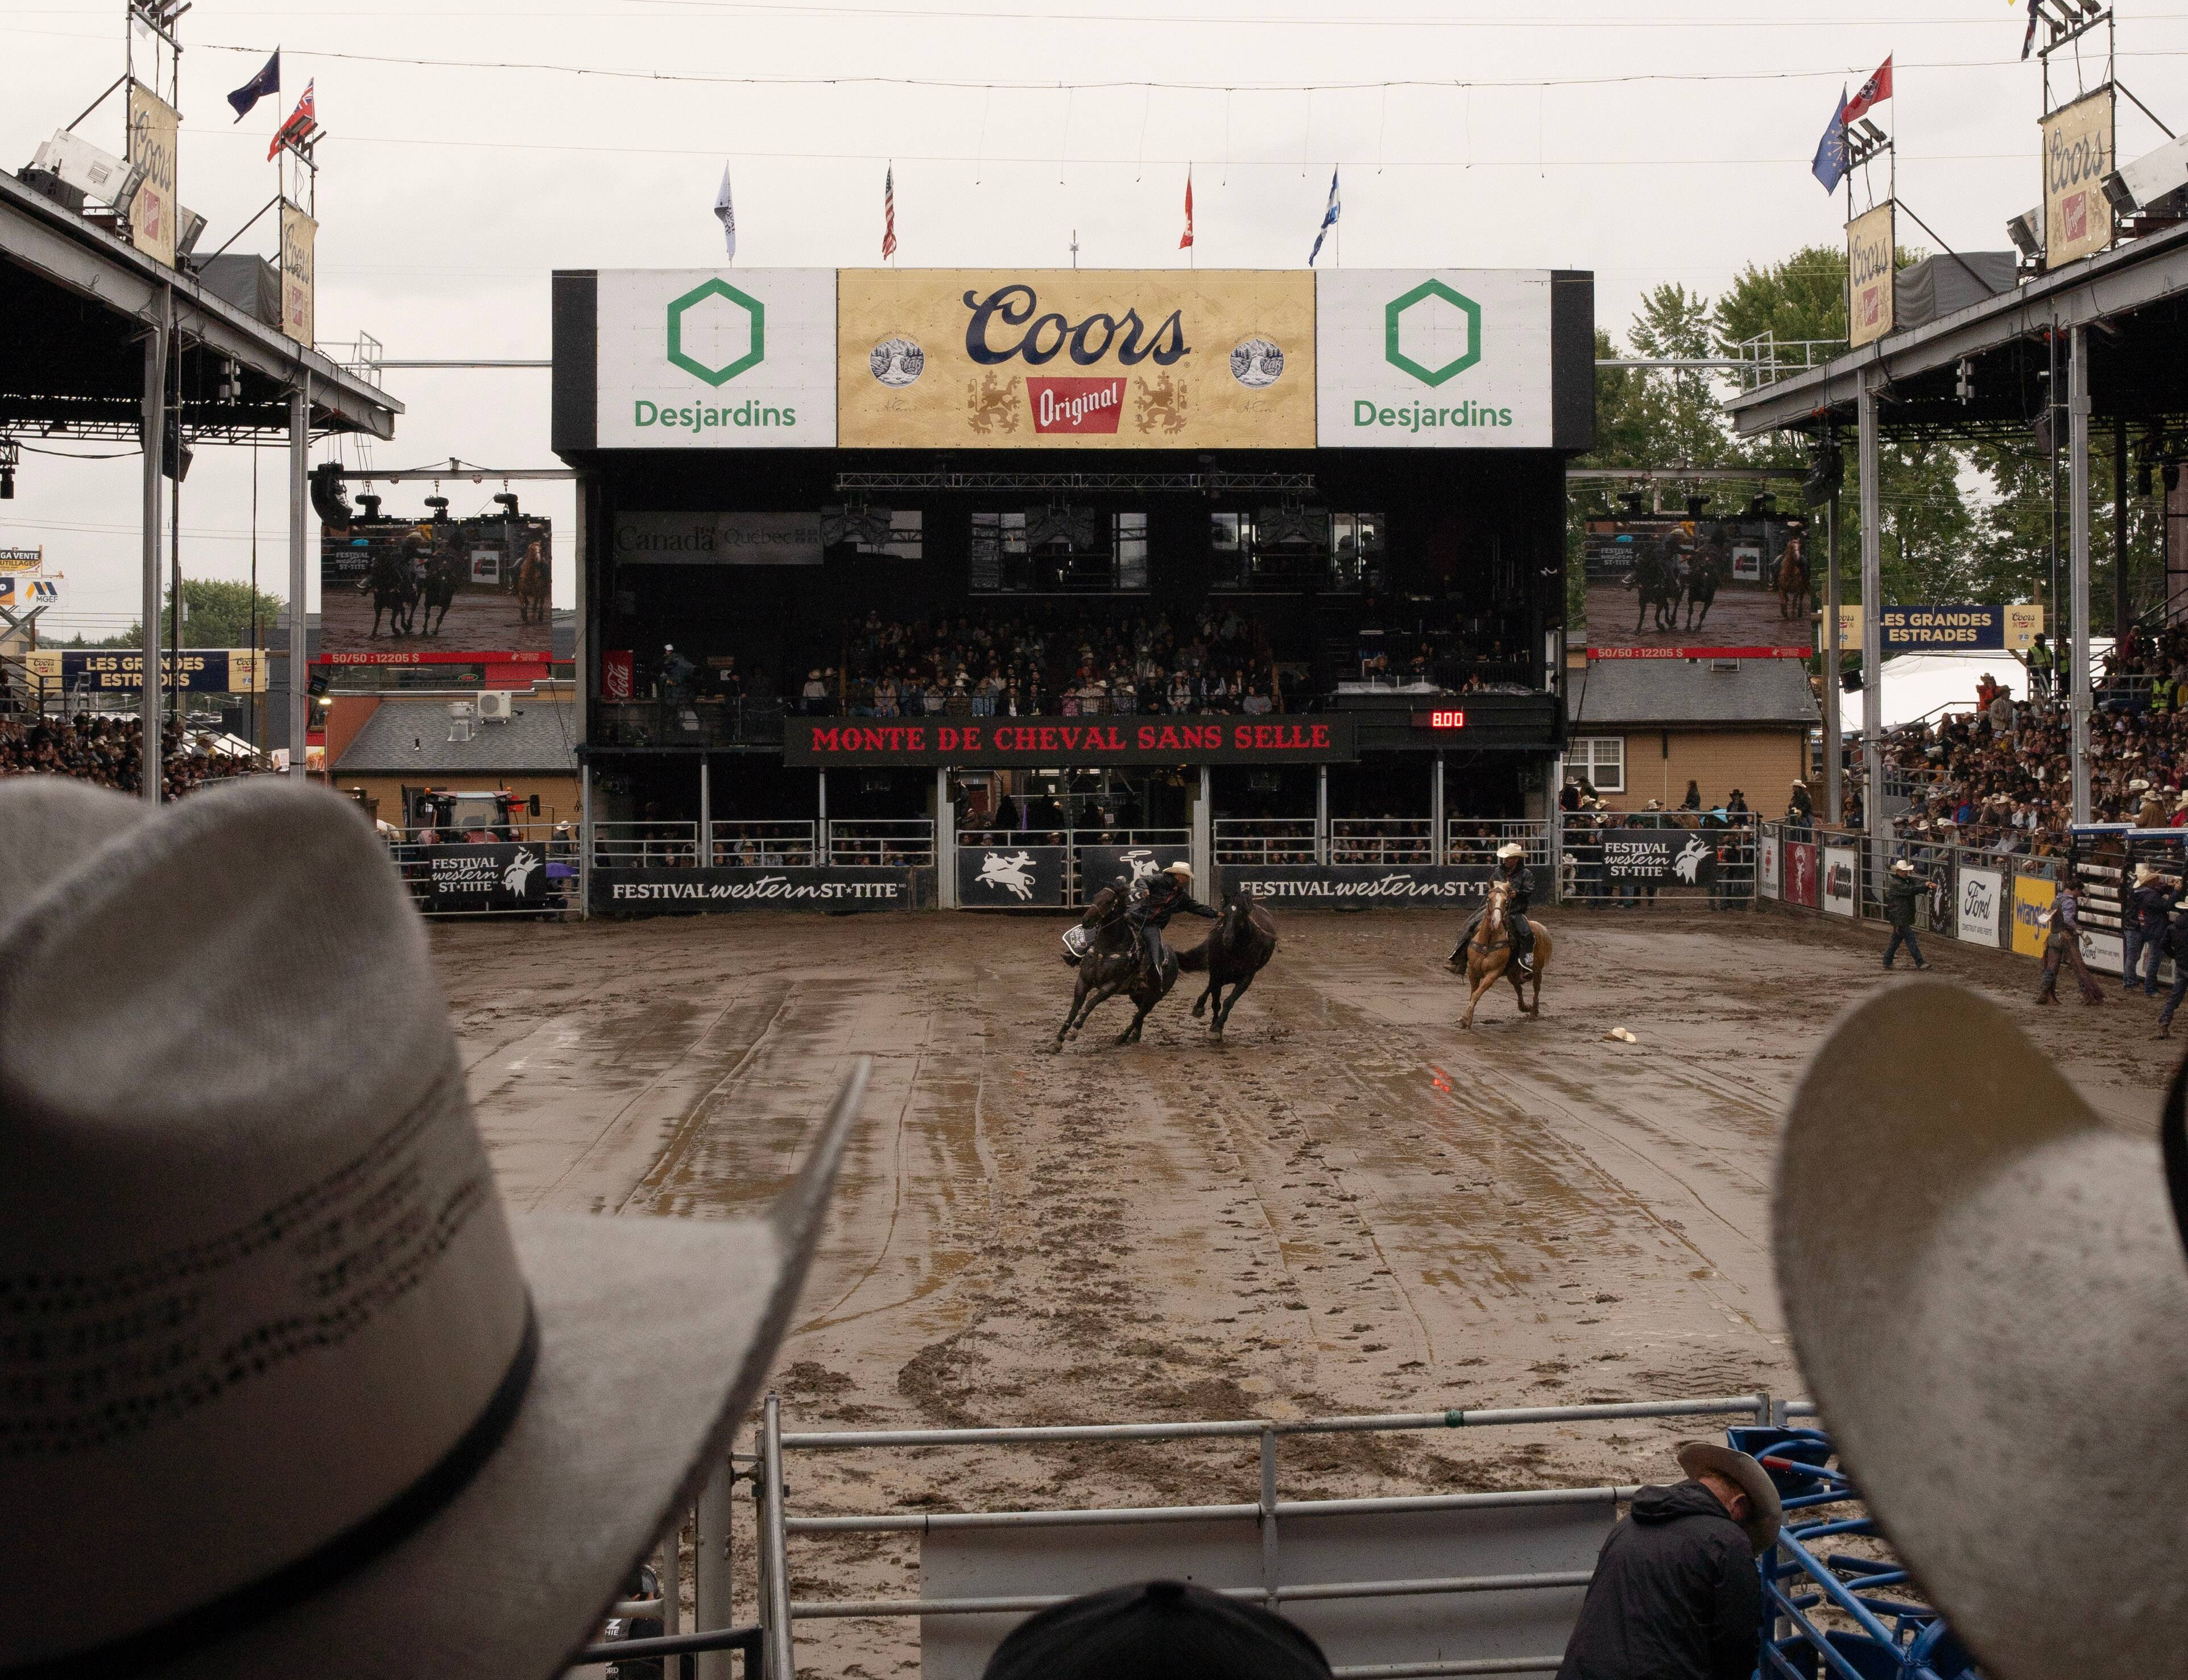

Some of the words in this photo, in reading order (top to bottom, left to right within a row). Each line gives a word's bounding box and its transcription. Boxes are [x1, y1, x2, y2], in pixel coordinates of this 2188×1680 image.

[134, 110, 171, 192] Coors
[2049, 127, 2104, 195] Coors
[1852, 234, 1888, 287] Coors
[963, 284, 1192, 366] Coors
[635, 400, 796, 433] Desjardins
[1040, 389, 1118, 427] Original
[1354, 400, 1513, 433] Desjardins
[618, 525, 715, 551] Canada
[724, 528, 792, 547] Québec
[1880, 614, 1905, 626] ES
[1910, 614, 1992, 626] GRANDES
[2012, 612, 2035, 621] Coors
[1889, 629, 1977, 642] ESTRADES
[86, 657, 117, 671] LES
[122, 657, 205, 671] GRNDES
[332, 654, 367, 663] 50/50
[376, 653, 410, 663] 12205
[412, 653, 419, 663] $
[1598, 648, 1632, 657] 50/50
[1641, 648, 1673, 657] 12205
[1676, 648, 1684, 658] $
[101, 673, 190, 686] ESTRDS
[607, 661, 629, 697] Cola
[1433, 712, 1463, 727] 8.00
[812, 727, 925, 751] MONTE
[938, 727, 981, 751] DE
[994, 726, 1126, 751] CHEVAL
[1138, 725, 1222, 750] SANS
[1234, 725, 1331, 749] SELLE
[1604, 843, 1670, 854] FESTIVAL
[1604, 851, 1670, 865] western
[432, 857, 498, 870] FESTIVAL
[432, 866, 499, 881] western
[613, 883, 709, 899] FESTIVAL
[709, 876, 822, 899] western
[1240, 882, 1335, 896] FESTIVAL
[1335, 874, 1445, 897] western
[1964, 880, 1992, 920] Ford
